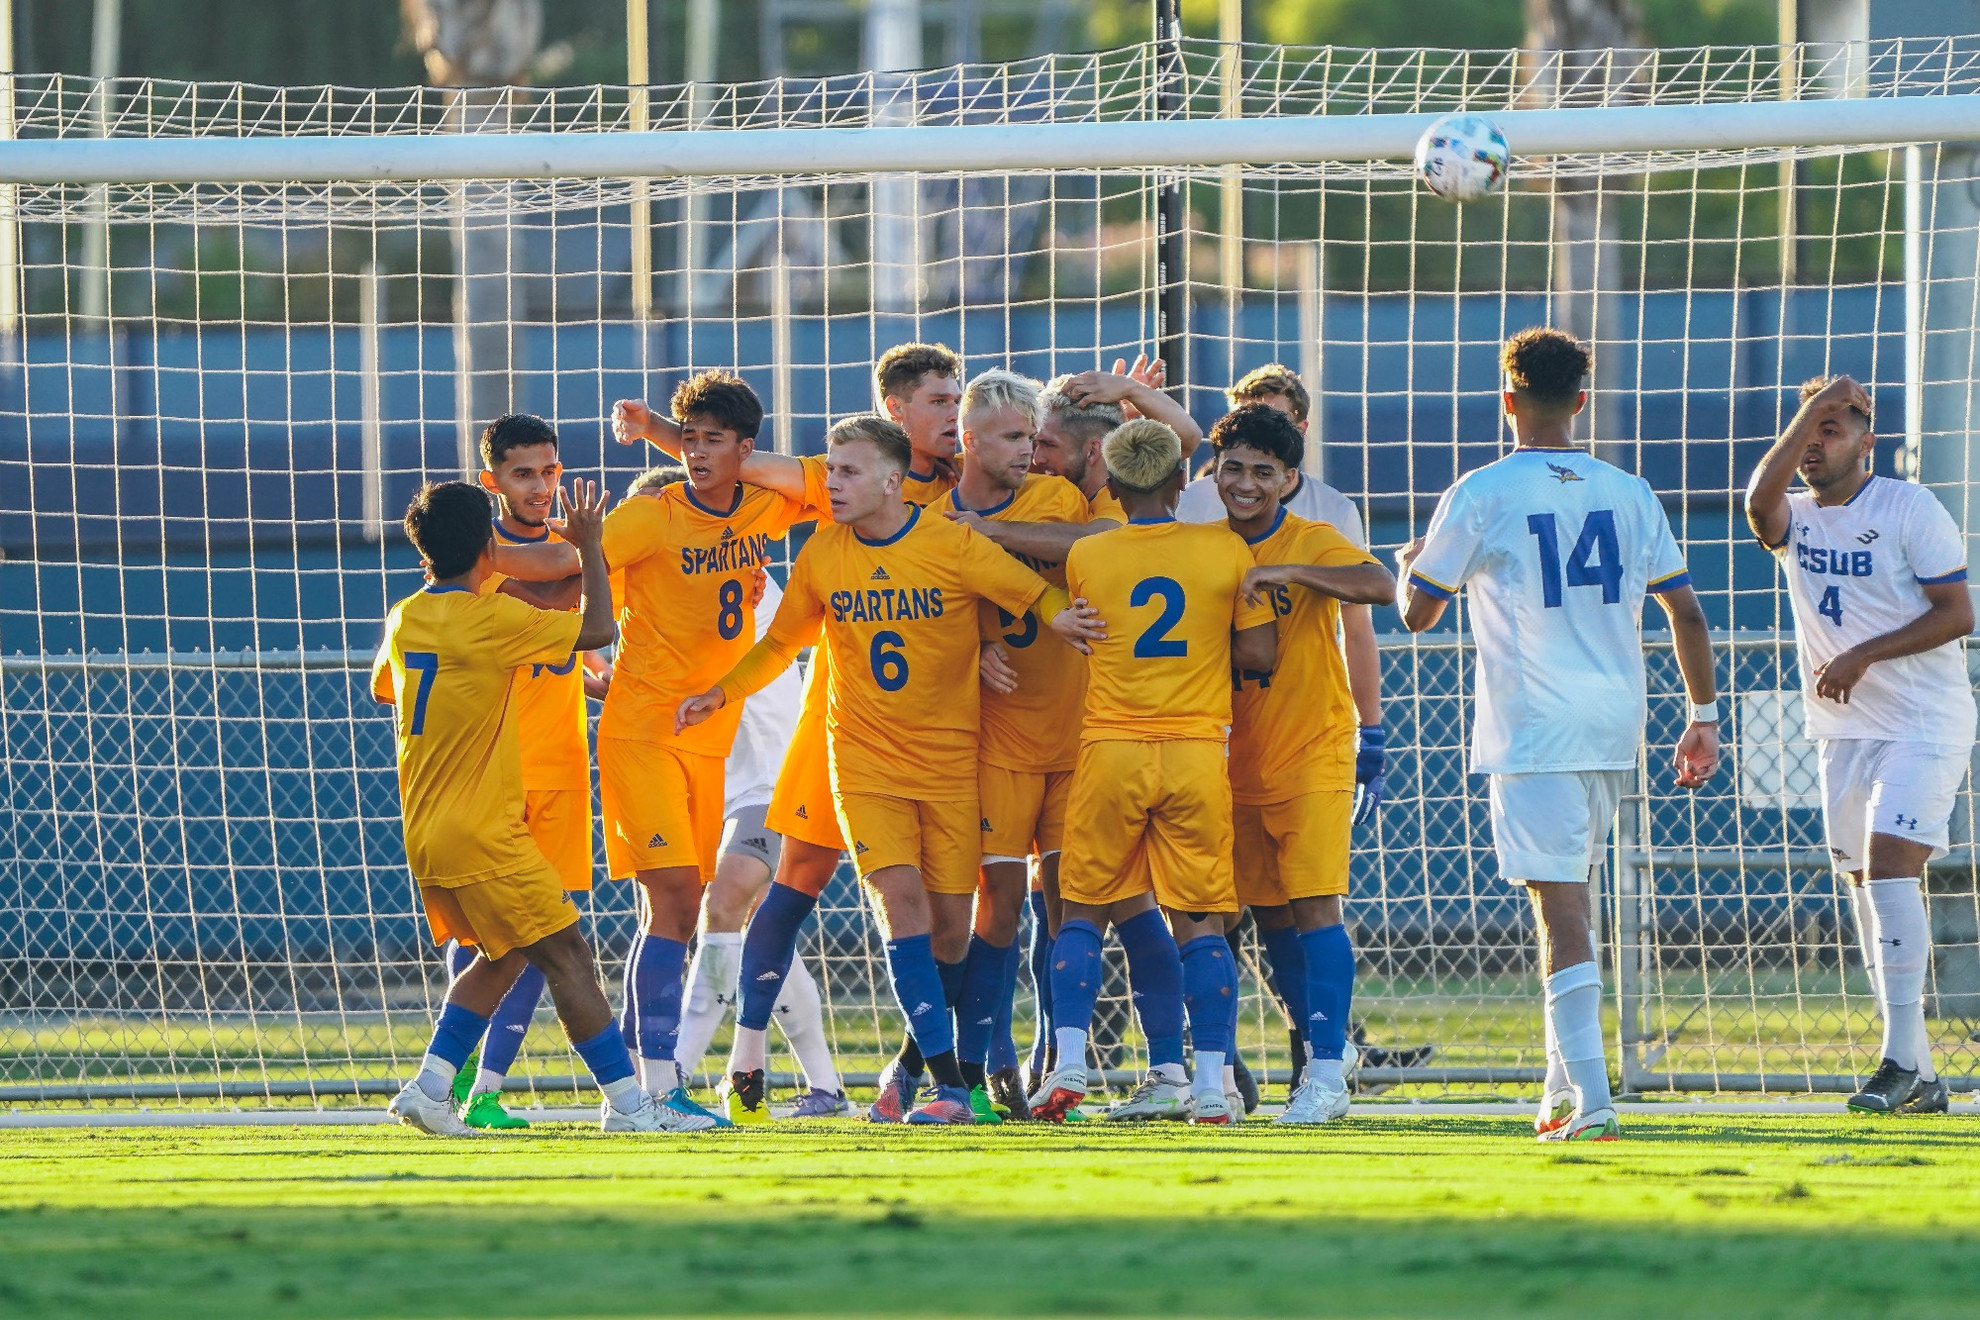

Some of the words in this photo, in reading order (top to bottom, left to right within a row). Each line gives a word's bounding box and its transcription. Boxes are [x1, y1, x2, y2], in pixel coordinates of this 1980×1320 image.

[1527, 510, 1623, 608] 14
[1797, 542, 1873, 576] CSUB
[718, 579, 743, 640] 8
[831, 587, 943, 622] SPARTANS
[1130, 576, 1187, 658] 2
[1818, 585, 1843, 627] 4
[870, 631, 909, 691] 6
[404, 652, 439, 735] 7
